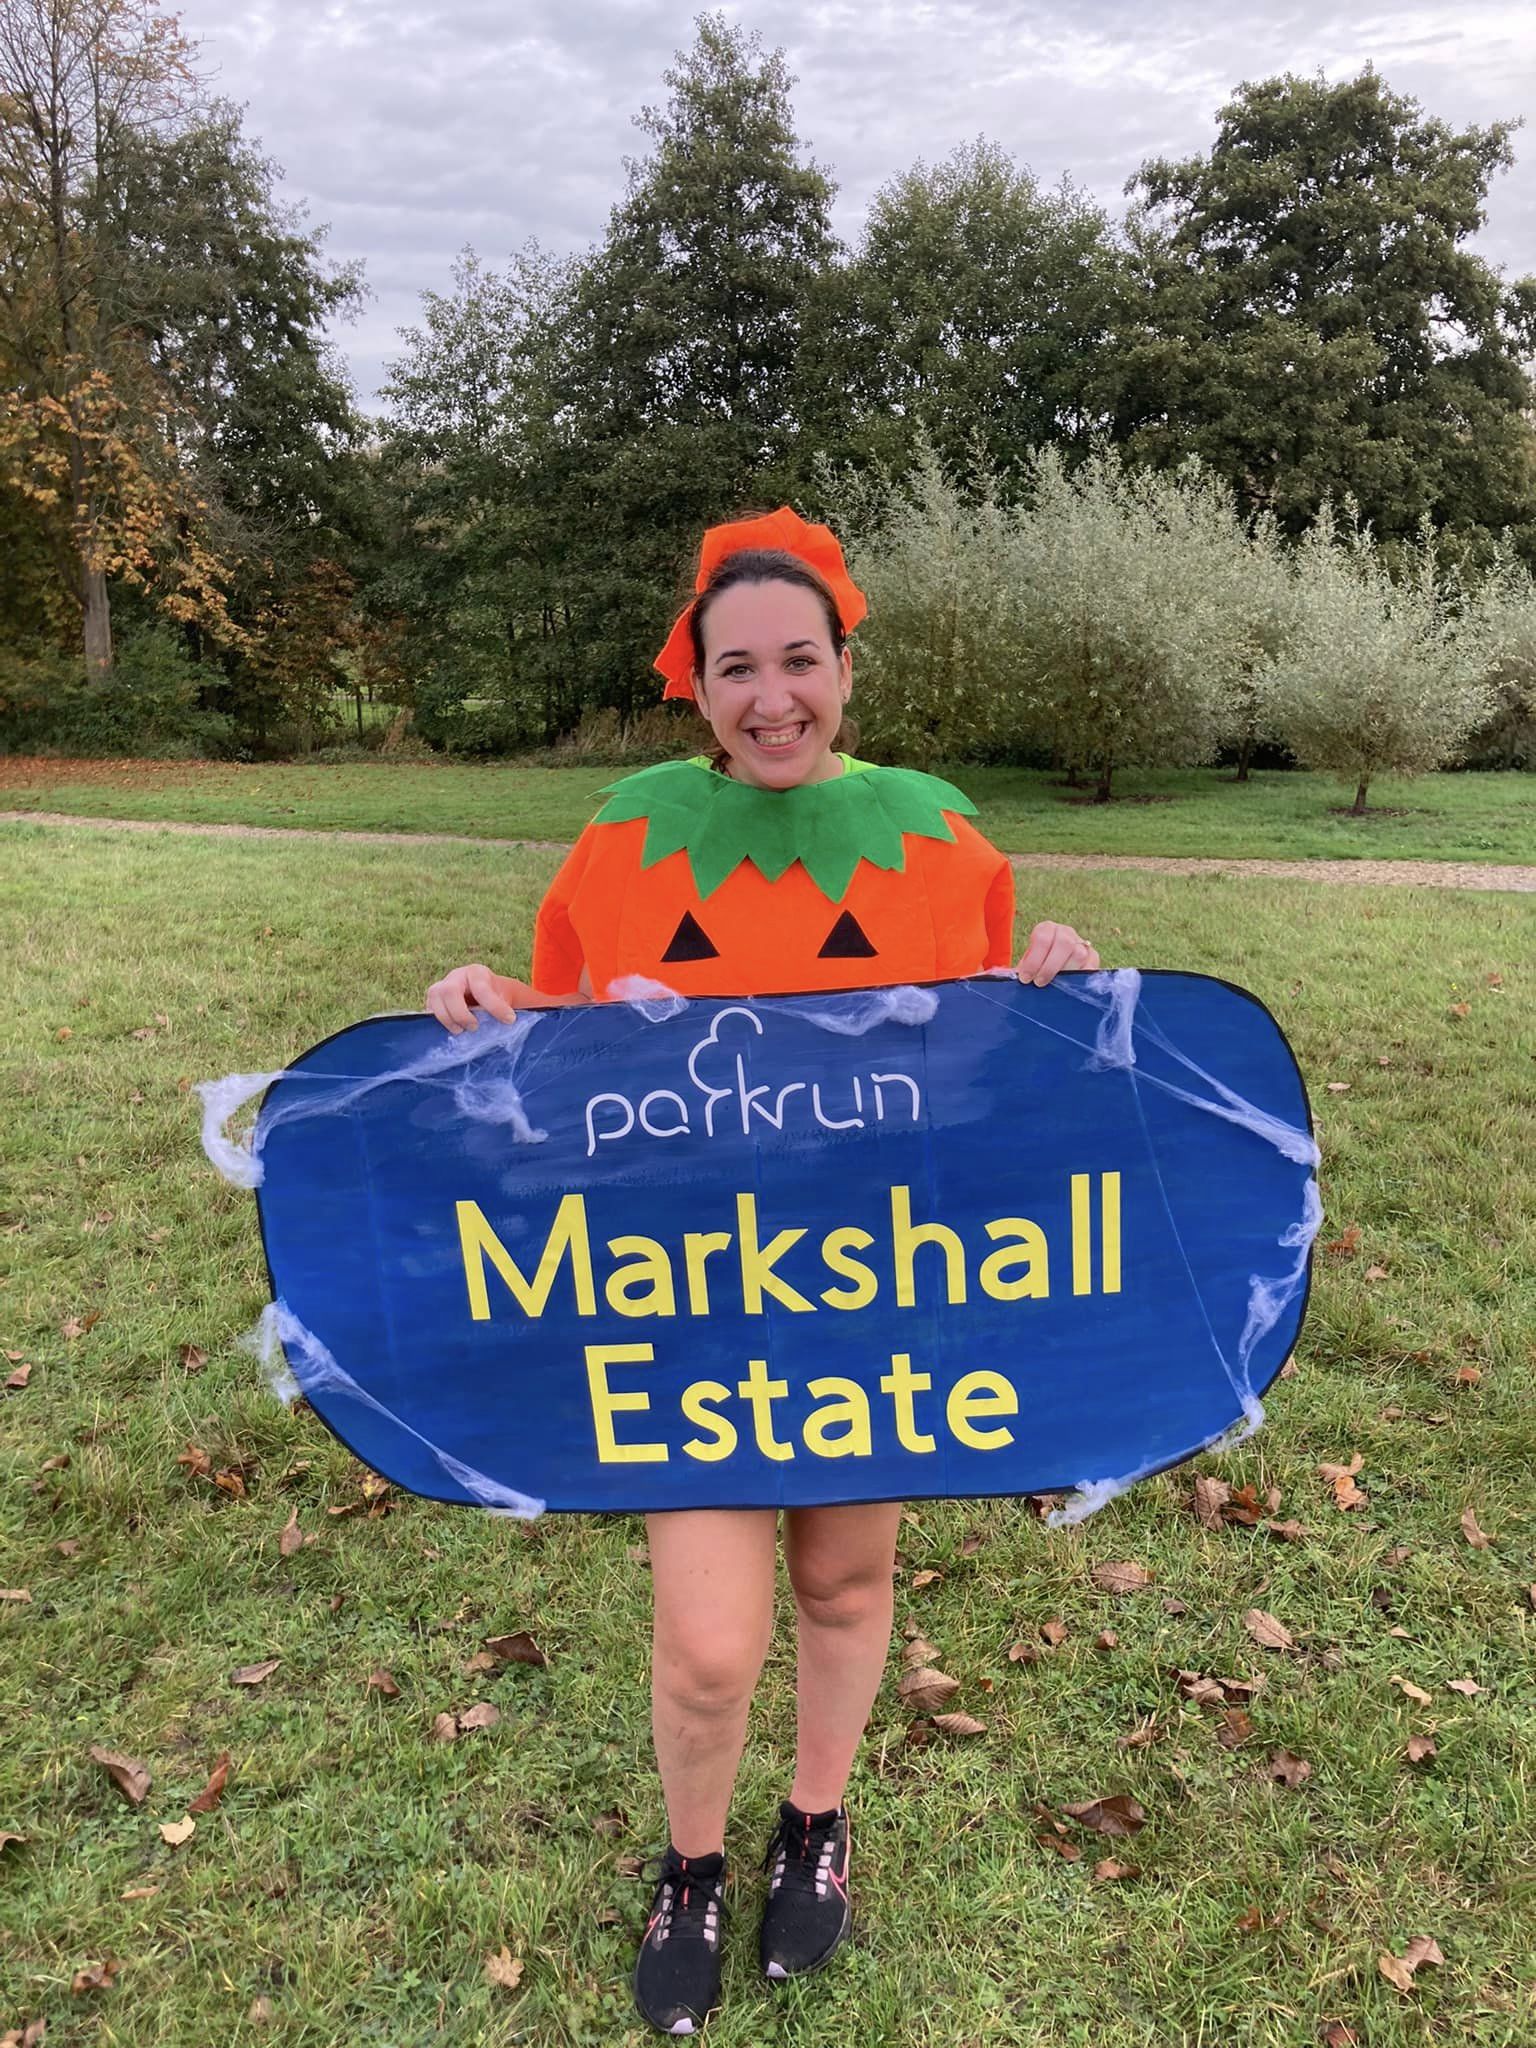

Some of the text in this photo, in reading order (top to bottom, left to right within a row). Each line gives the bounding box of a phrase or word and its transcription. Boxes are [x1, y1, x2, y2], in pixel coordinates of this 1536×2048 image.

[586, 1007, 920, 1156] parkrun
[456, 1172, 1121, 1321] Markshall
[584, 1343, 1018, 1463] Estate
